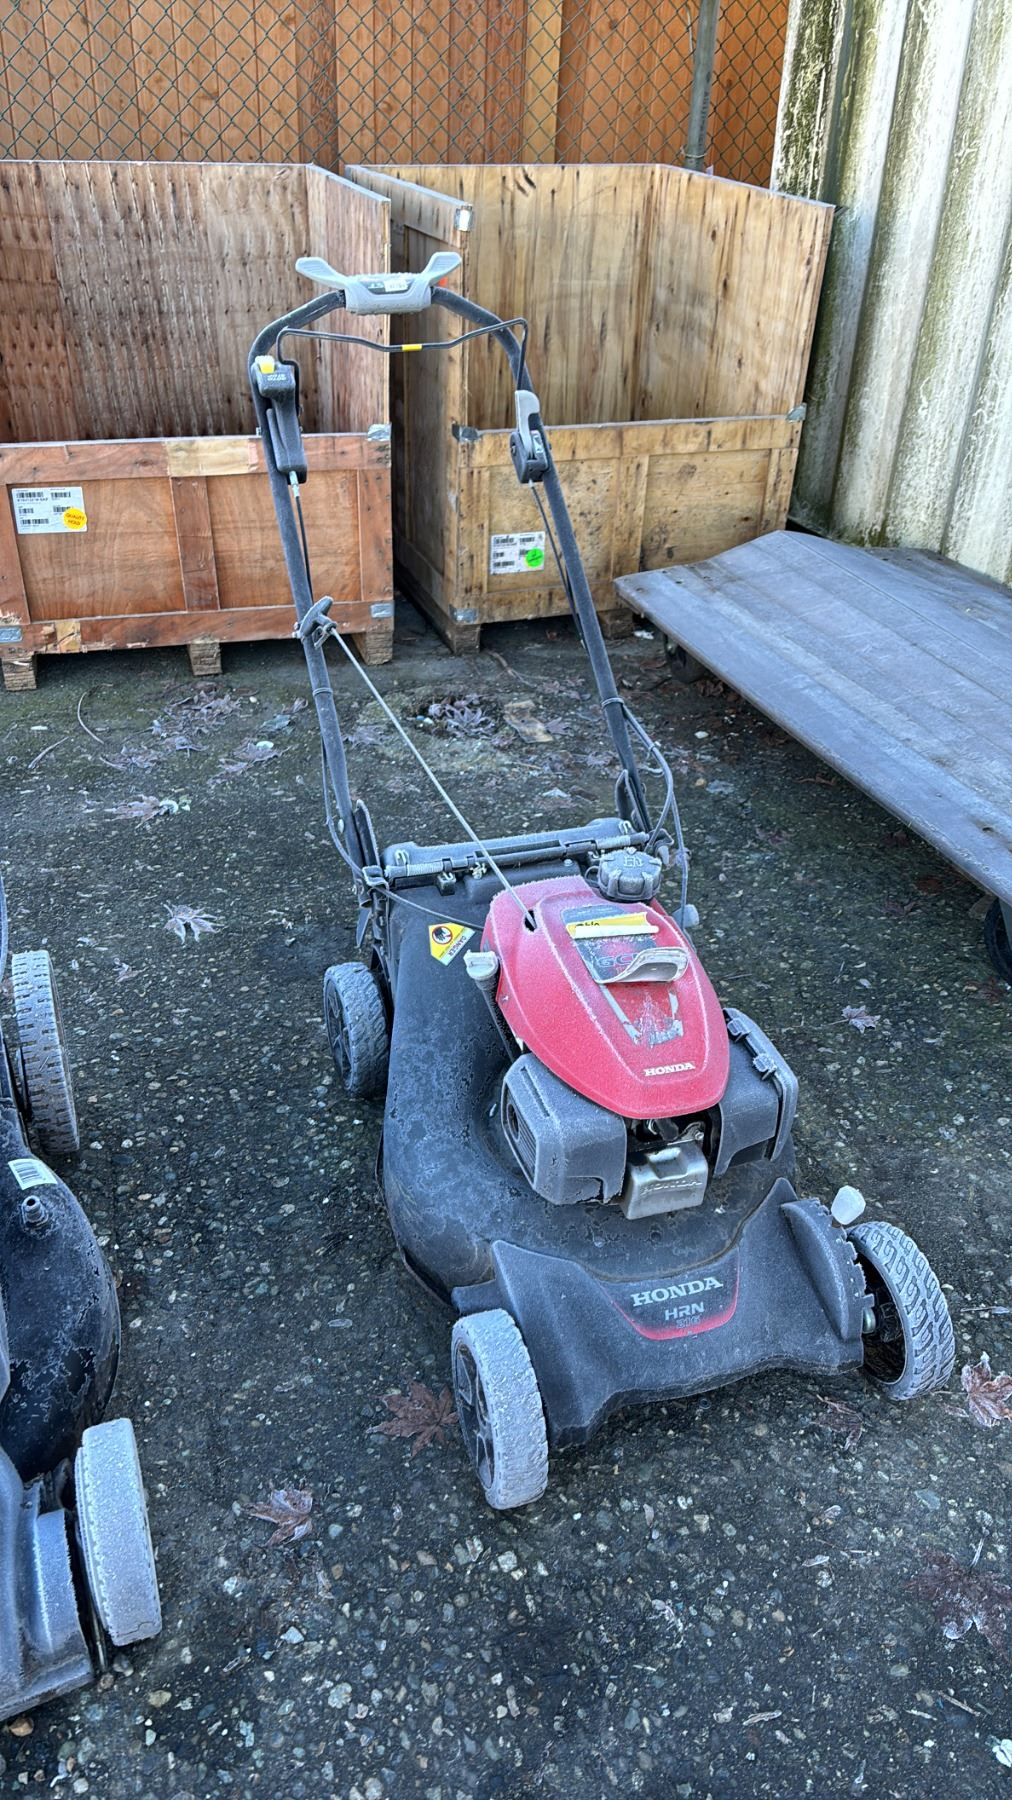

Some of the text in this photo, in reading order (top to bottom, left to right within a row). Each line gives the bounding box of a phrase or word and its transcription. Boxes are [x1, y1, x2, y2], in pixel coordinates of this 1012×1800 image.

[448, 935, 467, 957] DANGER
[643, 1061, 696, 1077] HONDA
[630, 1276, 724, 1307] HONDA
[664, 1301, 705, 1321] HRN
